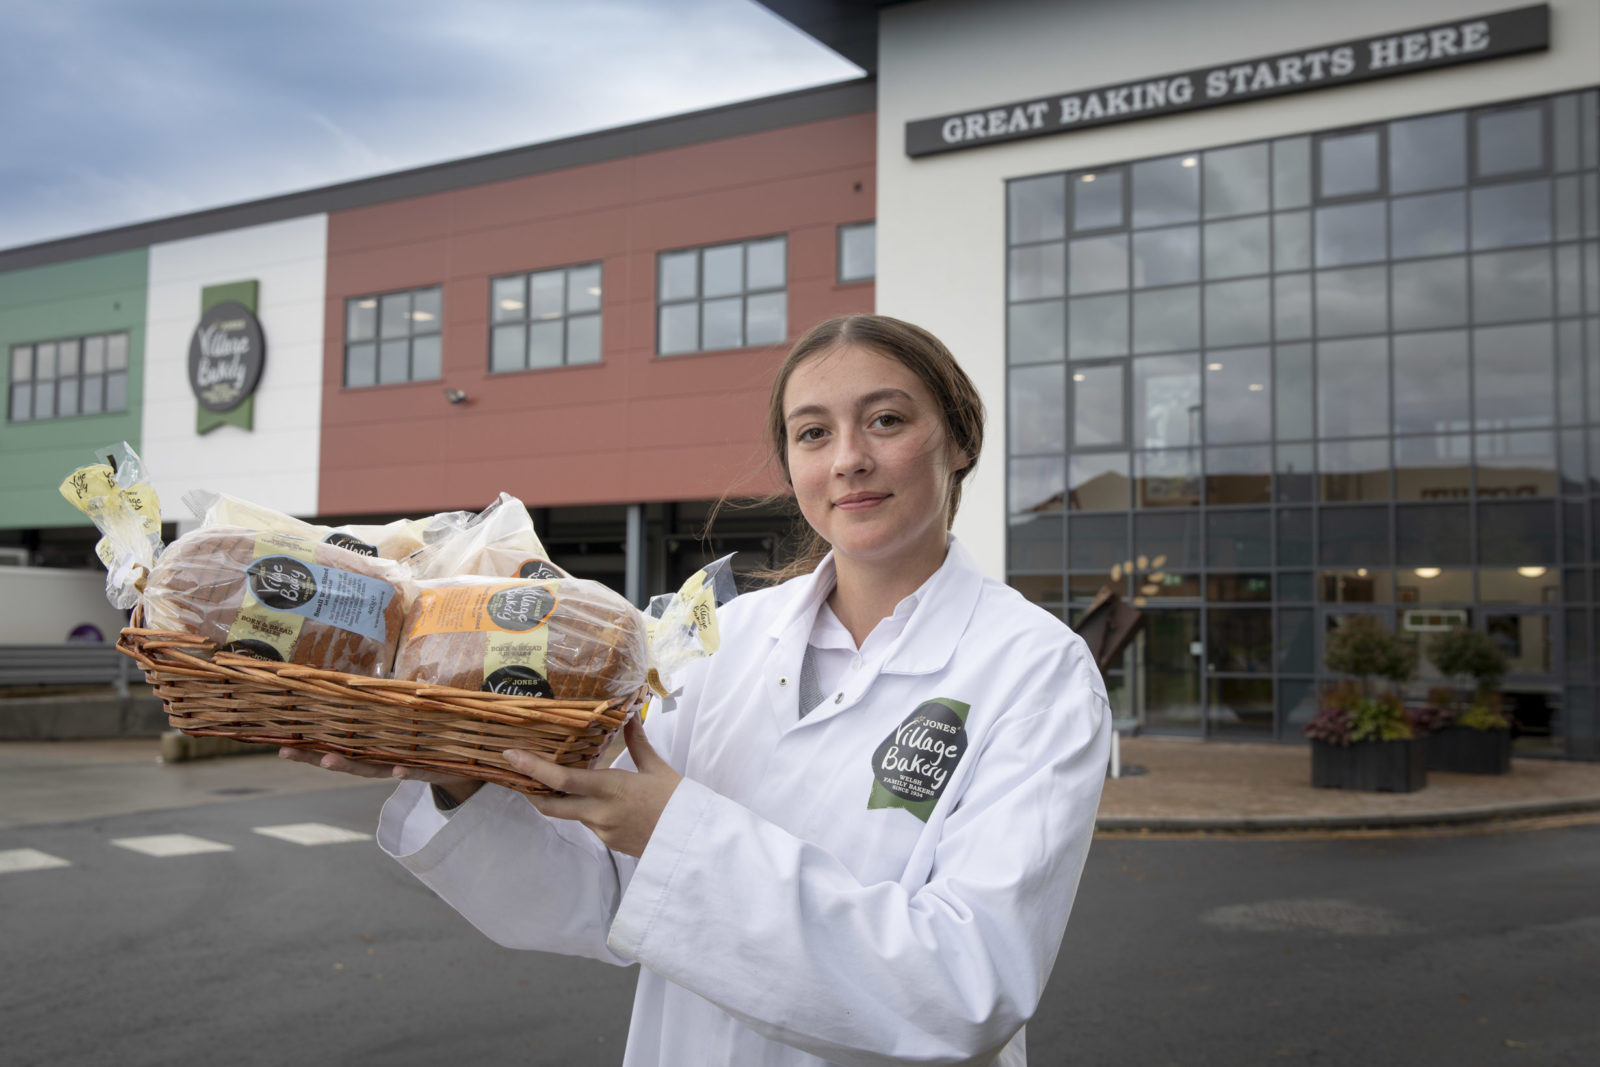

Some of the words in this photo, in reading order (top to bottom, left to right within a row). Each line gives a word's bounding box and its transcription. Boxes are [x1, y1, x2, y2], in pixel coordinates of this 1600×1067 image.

[942, 102, 1048, 143] GREAT
[1060, 77, 1192, 124] BAKING
[1206, 47, 1354, 98] STARTS
[1369, 22, 1490, 70] HERE
[241, 615, 261, 626] BORN
[269, 624, 293, 635] BREAD
[923, 720, 957, 735] JONES
[895, 720, 957, 766] Village
[881, 746, 948, 790] Bakery
[883, 777, 908, 788] FAMILY
[908, 783, 935, 796] BAKERS
[892, 785, 909, 794] SINCE
[900, 774, 923, 786] WELSH
